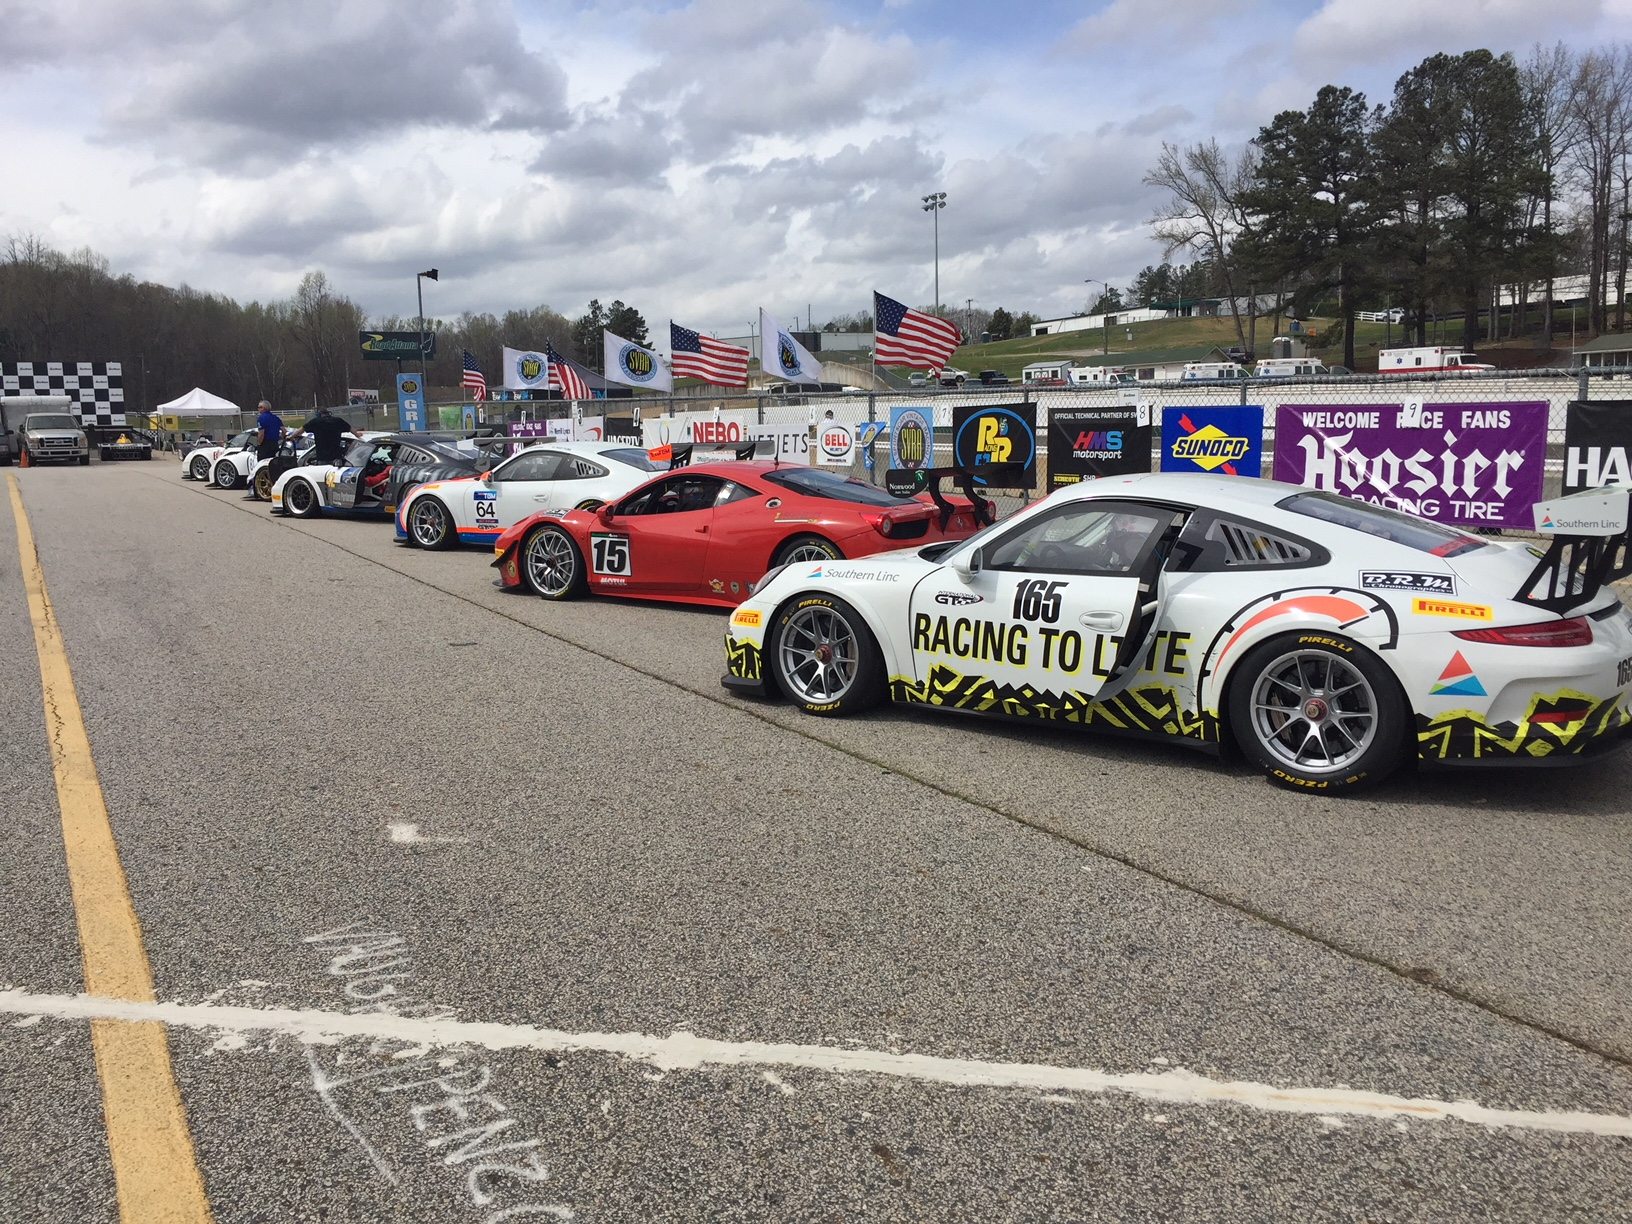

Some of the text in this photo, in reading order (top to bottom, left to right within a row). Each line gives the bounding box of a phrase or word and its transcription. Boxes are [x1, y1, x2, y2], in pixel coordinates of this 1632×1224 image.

[1140, 405, 1146, 419] 8
[1410, 403, 1418, 418] 9
[1303, 410, 1511, 429] WELCOME RCE FANS
[693, 421, 740, 443] NEBO
[825, 434, 848, 446] BELL
[1073, 431, 1122, 450] HMS
[901, 428, 922, 460] SVRA
[1175, 439, 1245, 457] SUNOCO
[1073, 450, 1122, 461] motorsport
[1297, 429, 1525, 499] Hoosier
[889, 482, 915, 490] Norwood
[476, 501, 495, 518] 64
[1449, 500, 1504, 520] TIRE
[1556, 520, 1620, 528] Southern Linc
[594, 539, 627, 573] 15
[824, 568, 899, 582] Southern Linc
[798, 599, 833, 608] PIRELLI
[1013, 579, 1069, 624] 165
[1419, 600, 1485, 617] PIRELLI
[734, 612, 759, 624] PIRELLI
[914, 612, 1028, 665] RACING
[1038, 627, 1082, 673] TO
[1299, 636, 1353, 653] PIRELLI
